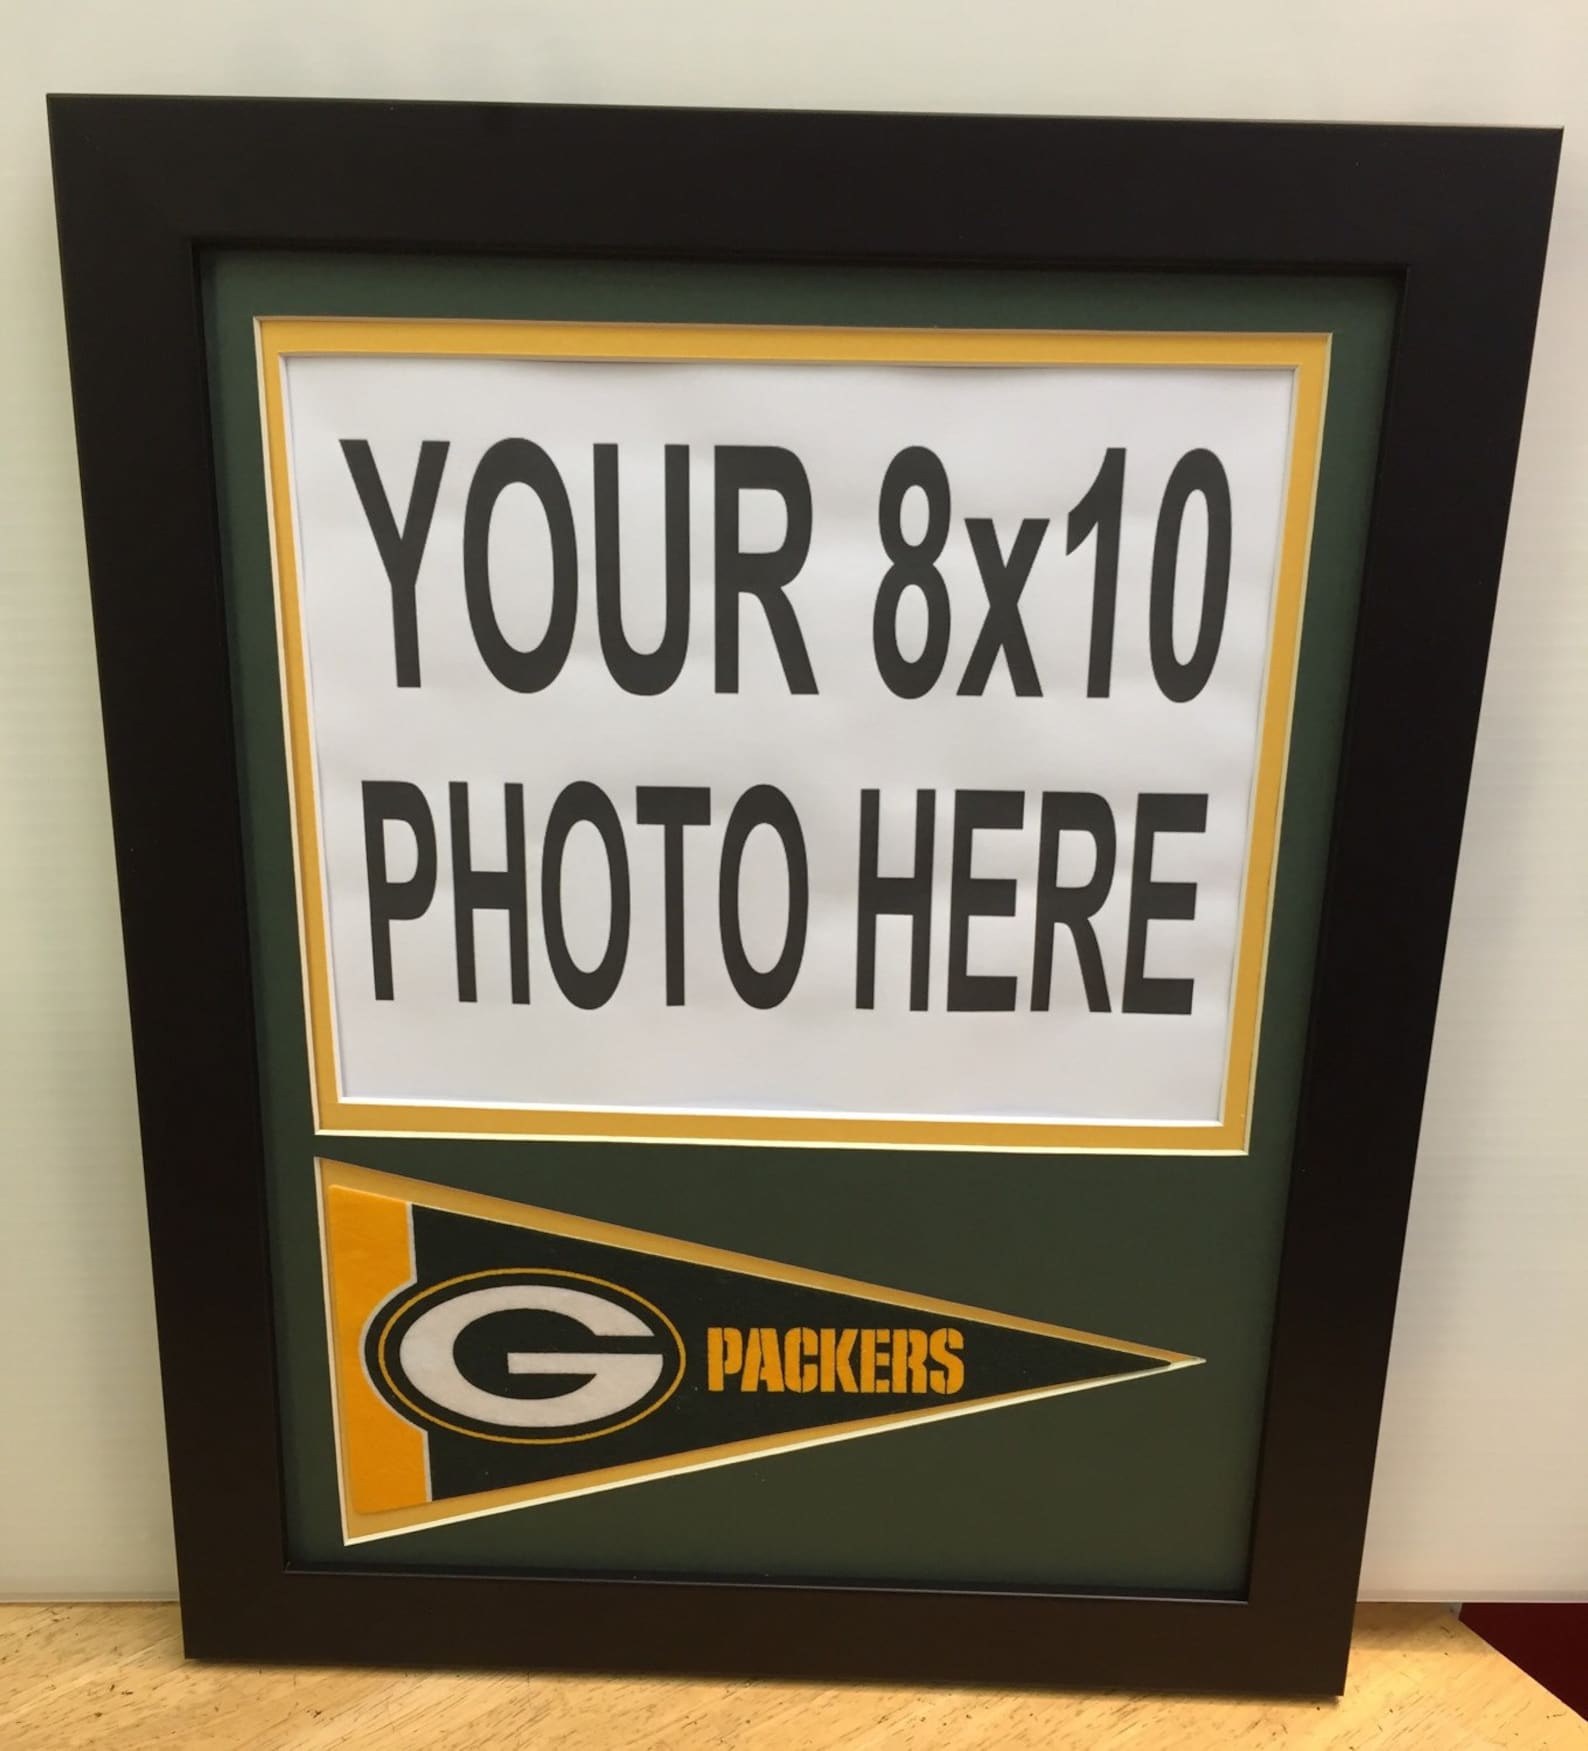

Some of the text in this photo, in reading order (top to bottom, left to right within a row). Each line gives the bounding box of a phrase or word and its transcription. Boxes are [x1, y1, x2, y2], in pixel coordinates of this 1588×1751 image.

[339, 437, 1231, 703] YOUR 8x10
[361, 780, 1209, 1015] PHOTO HERE
[400, 1285, 663, 1427] G
[707, 1326, 965, 1395] PACKERS
